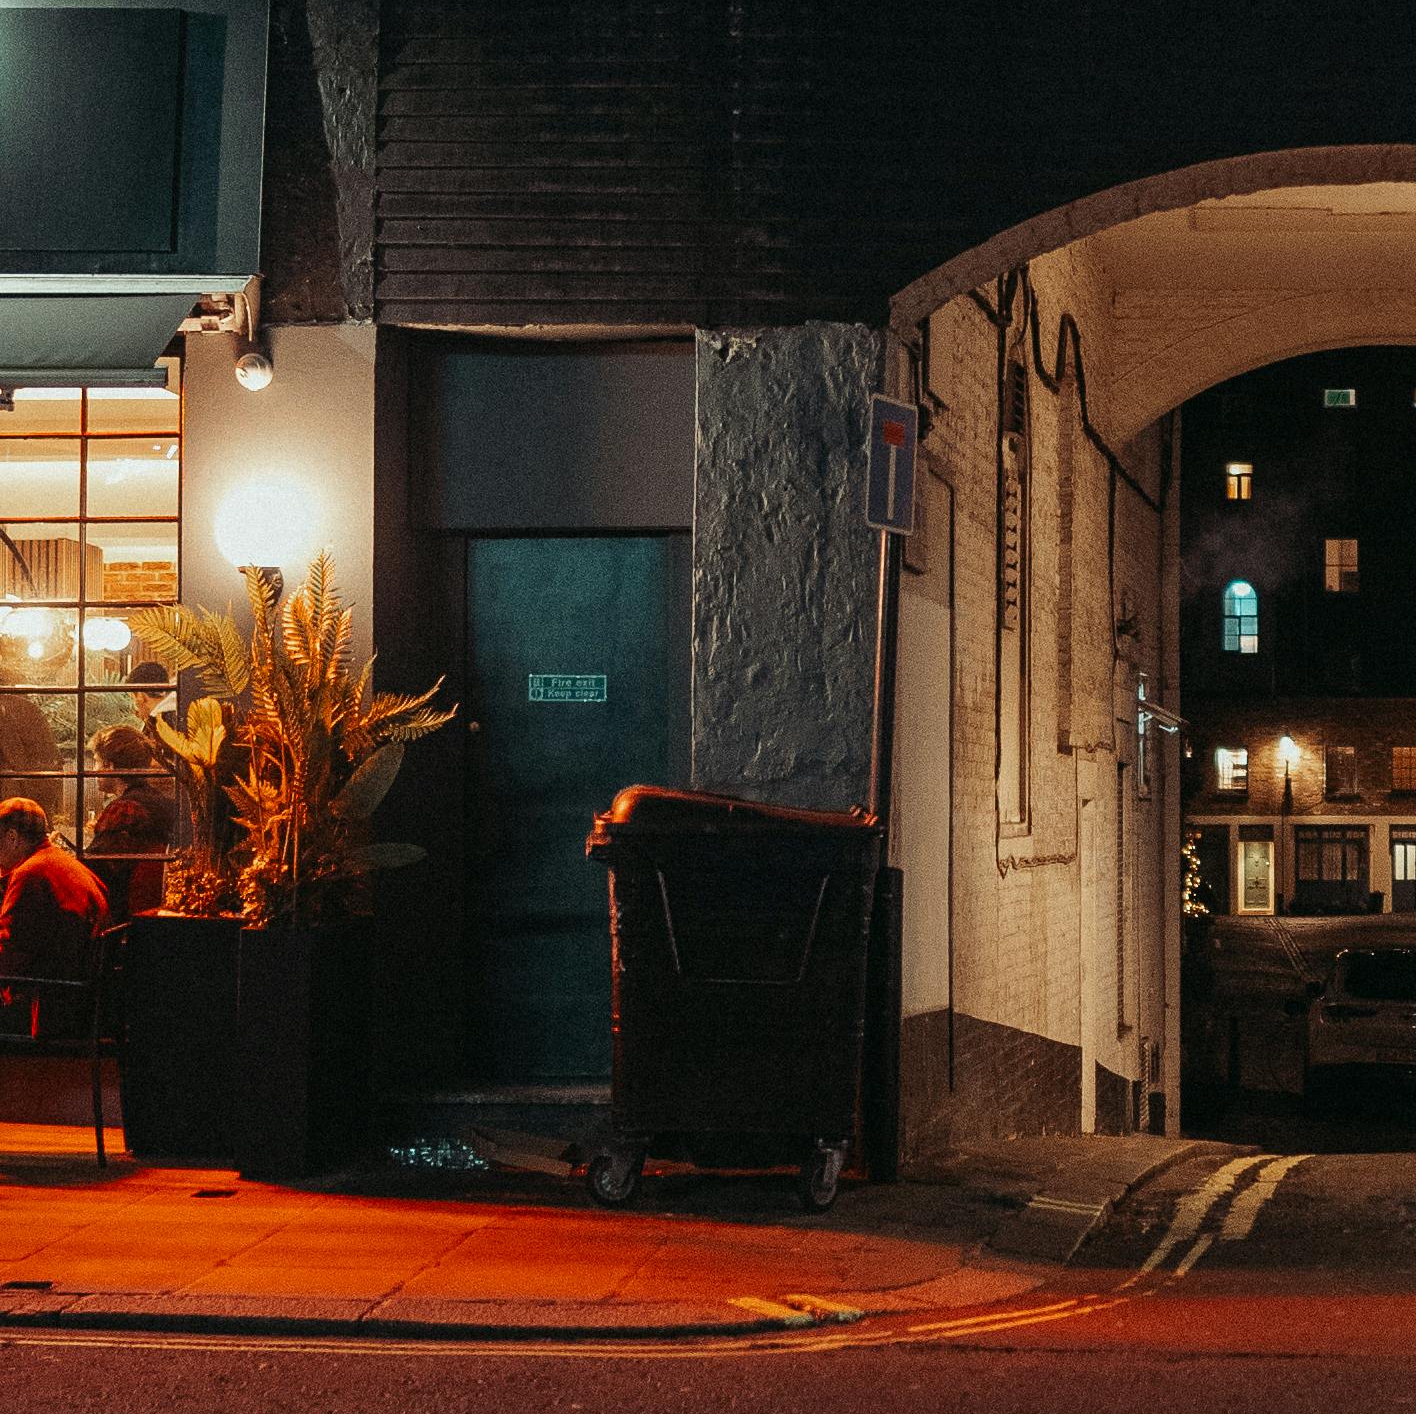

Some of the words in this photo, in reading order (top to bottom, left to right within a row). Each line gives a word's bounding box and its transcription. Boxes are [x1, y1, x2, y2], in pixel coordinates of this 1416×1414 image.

[551, 678, 572, 688] Fire
[575, 678, 596, 688] exit
[547, 689, 572, 699] Keep
[575, 689, 599, 698] clear
